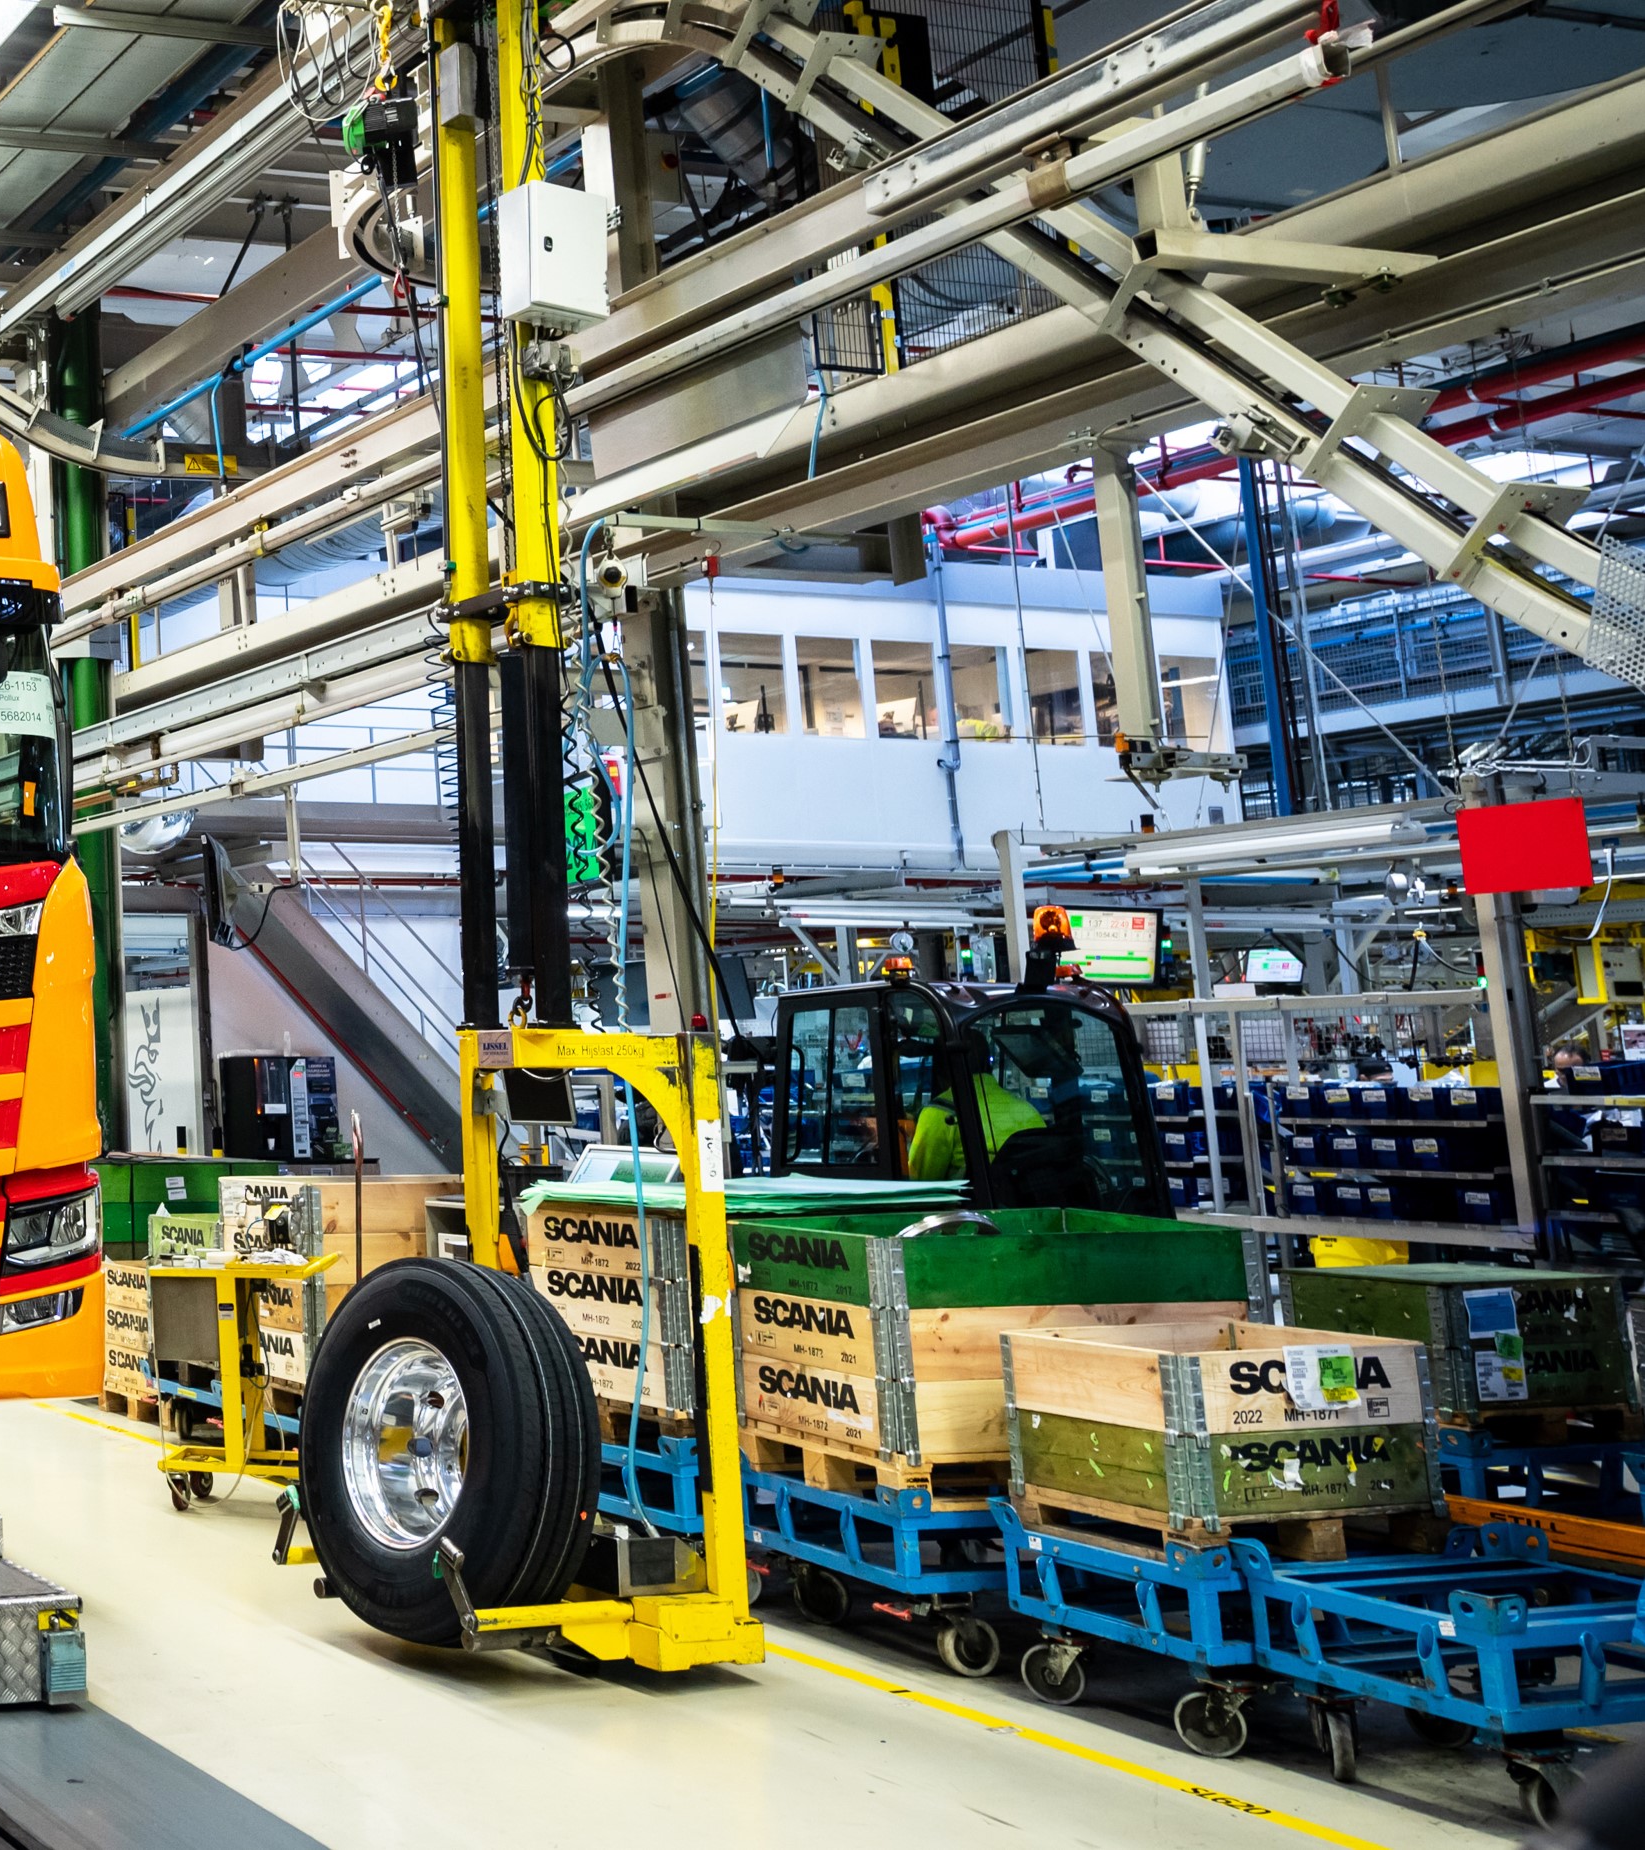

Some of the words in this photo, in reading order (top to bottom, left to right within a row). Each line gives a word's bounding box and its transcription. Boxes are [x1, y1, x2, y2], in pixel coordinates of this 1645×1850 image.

[0, 710, 41, 722] 5682014
[557, 1045, 579, 1056] Max.
[582, 1045, 614, 1058] Hijslast
[616, 1045, 644, 1058] 250kg
[161, 1225, 204, 1247] SCANIA
[543, 1216, 639, 1249] SCANIA
[748, 1231, 850, 1272] SCANIA
[580, 1256, 609, 1268] MH-1872
[625, 1261, 641, 1271] 2022
[107, 1269, 148, 1291] SCANIA
[547, 1270, 644, 1307] SCANIA
[107, 1309, 149, 1333] SCANIA
[582, 1312, 610, 1325] MH-1872
[631, 1319, 642, 1329] 202
[753, 1295, 855, 1339] SCANIA
[108, 1349, 147, 1373] SCAN
[573, 1334, 648, 1372] CANIA
[841, 1352, 857, 1364] 2021
[590, 1377, 614, 1389] H-1872
[1229, 1356, 1391, 1395] SCIA
[758, 1365, 860, 1415] SCANIA
[798, 1416, 828, 1431] MH-1872
[845, 1427, 862, 1439] 2021
[1233, 1410, 1263, 1424] 2022
[1232, 1434, 1391, 1472] SCANIA
[1301, 1482, 1348, 1497] MH-1871
[1370, 1479, 1395, 1491] 208
